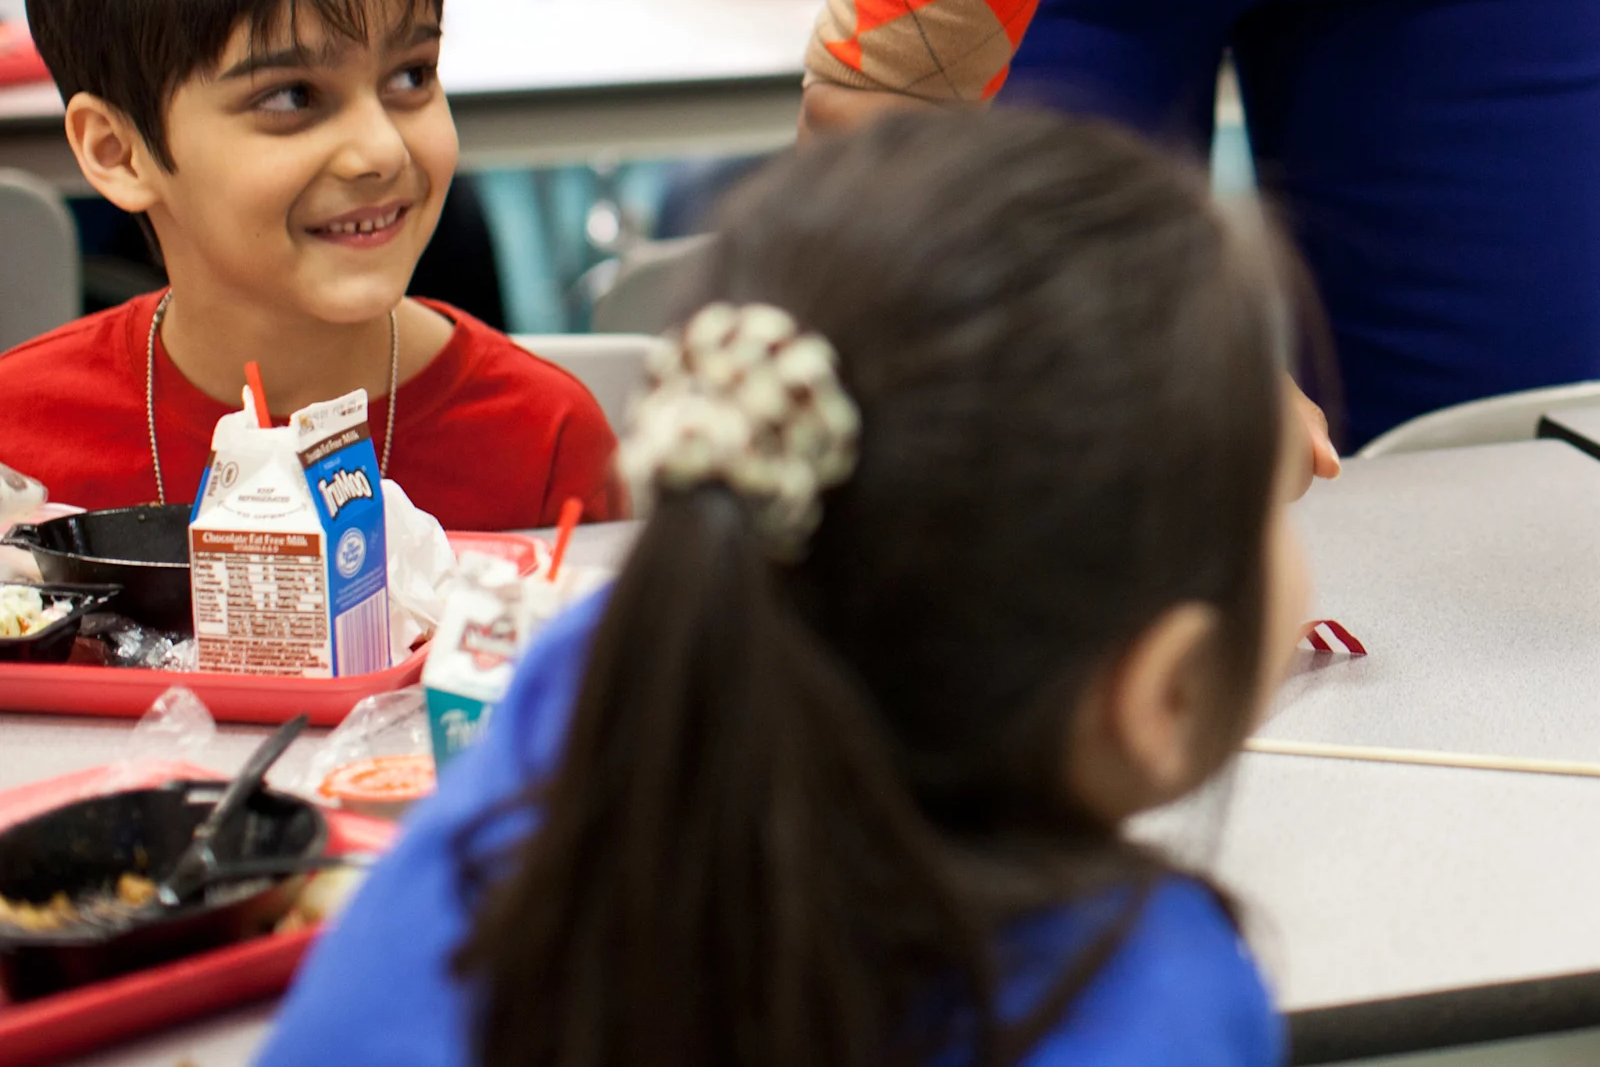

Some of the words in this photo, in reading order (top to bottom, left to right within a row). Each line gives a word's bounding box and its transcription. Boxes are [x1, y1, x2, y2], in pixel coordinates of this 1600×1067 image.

[317, 468, 374, 519] TruMoo
[202, 531, 248, 545] Chocolate
[249, 533, 263, 545] Fat
[264, 534, 285, 546] Free
[286, 535, 308, 547] Milk
